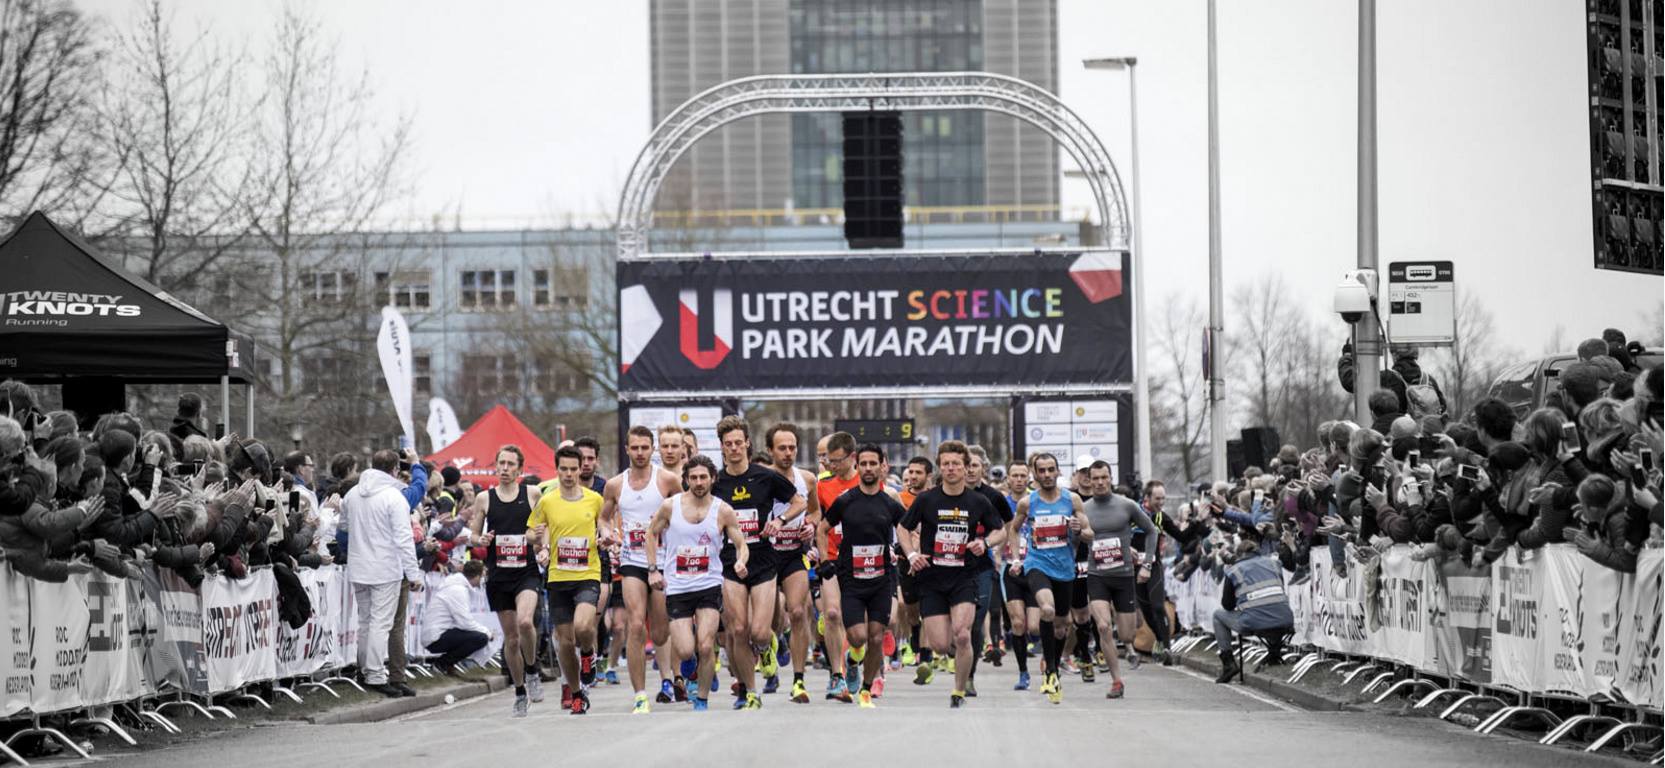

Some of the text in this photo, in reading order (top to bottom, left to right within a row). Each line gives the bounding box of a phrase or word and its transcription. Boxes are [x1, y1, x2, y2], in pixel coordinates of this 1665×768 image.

[7, 290, 124, 304] TWENTY
[8, 301, 141, 317] KNOTS
[741, 288, 1064, 323] UTRECHT SCIENCE
[5, 318, 69, 327] Running
[741, 323, 1065, 359] PARK MARATHON
[0, 355, 17, 368] ing
[501, 545, 523, 555] David
[559, 547, 588, 558] Nathan
[942, 543, 961, 554] Dirk
[1094, 548, 1121, 559] Andrea
[863, 556, 875, 566] Ad
